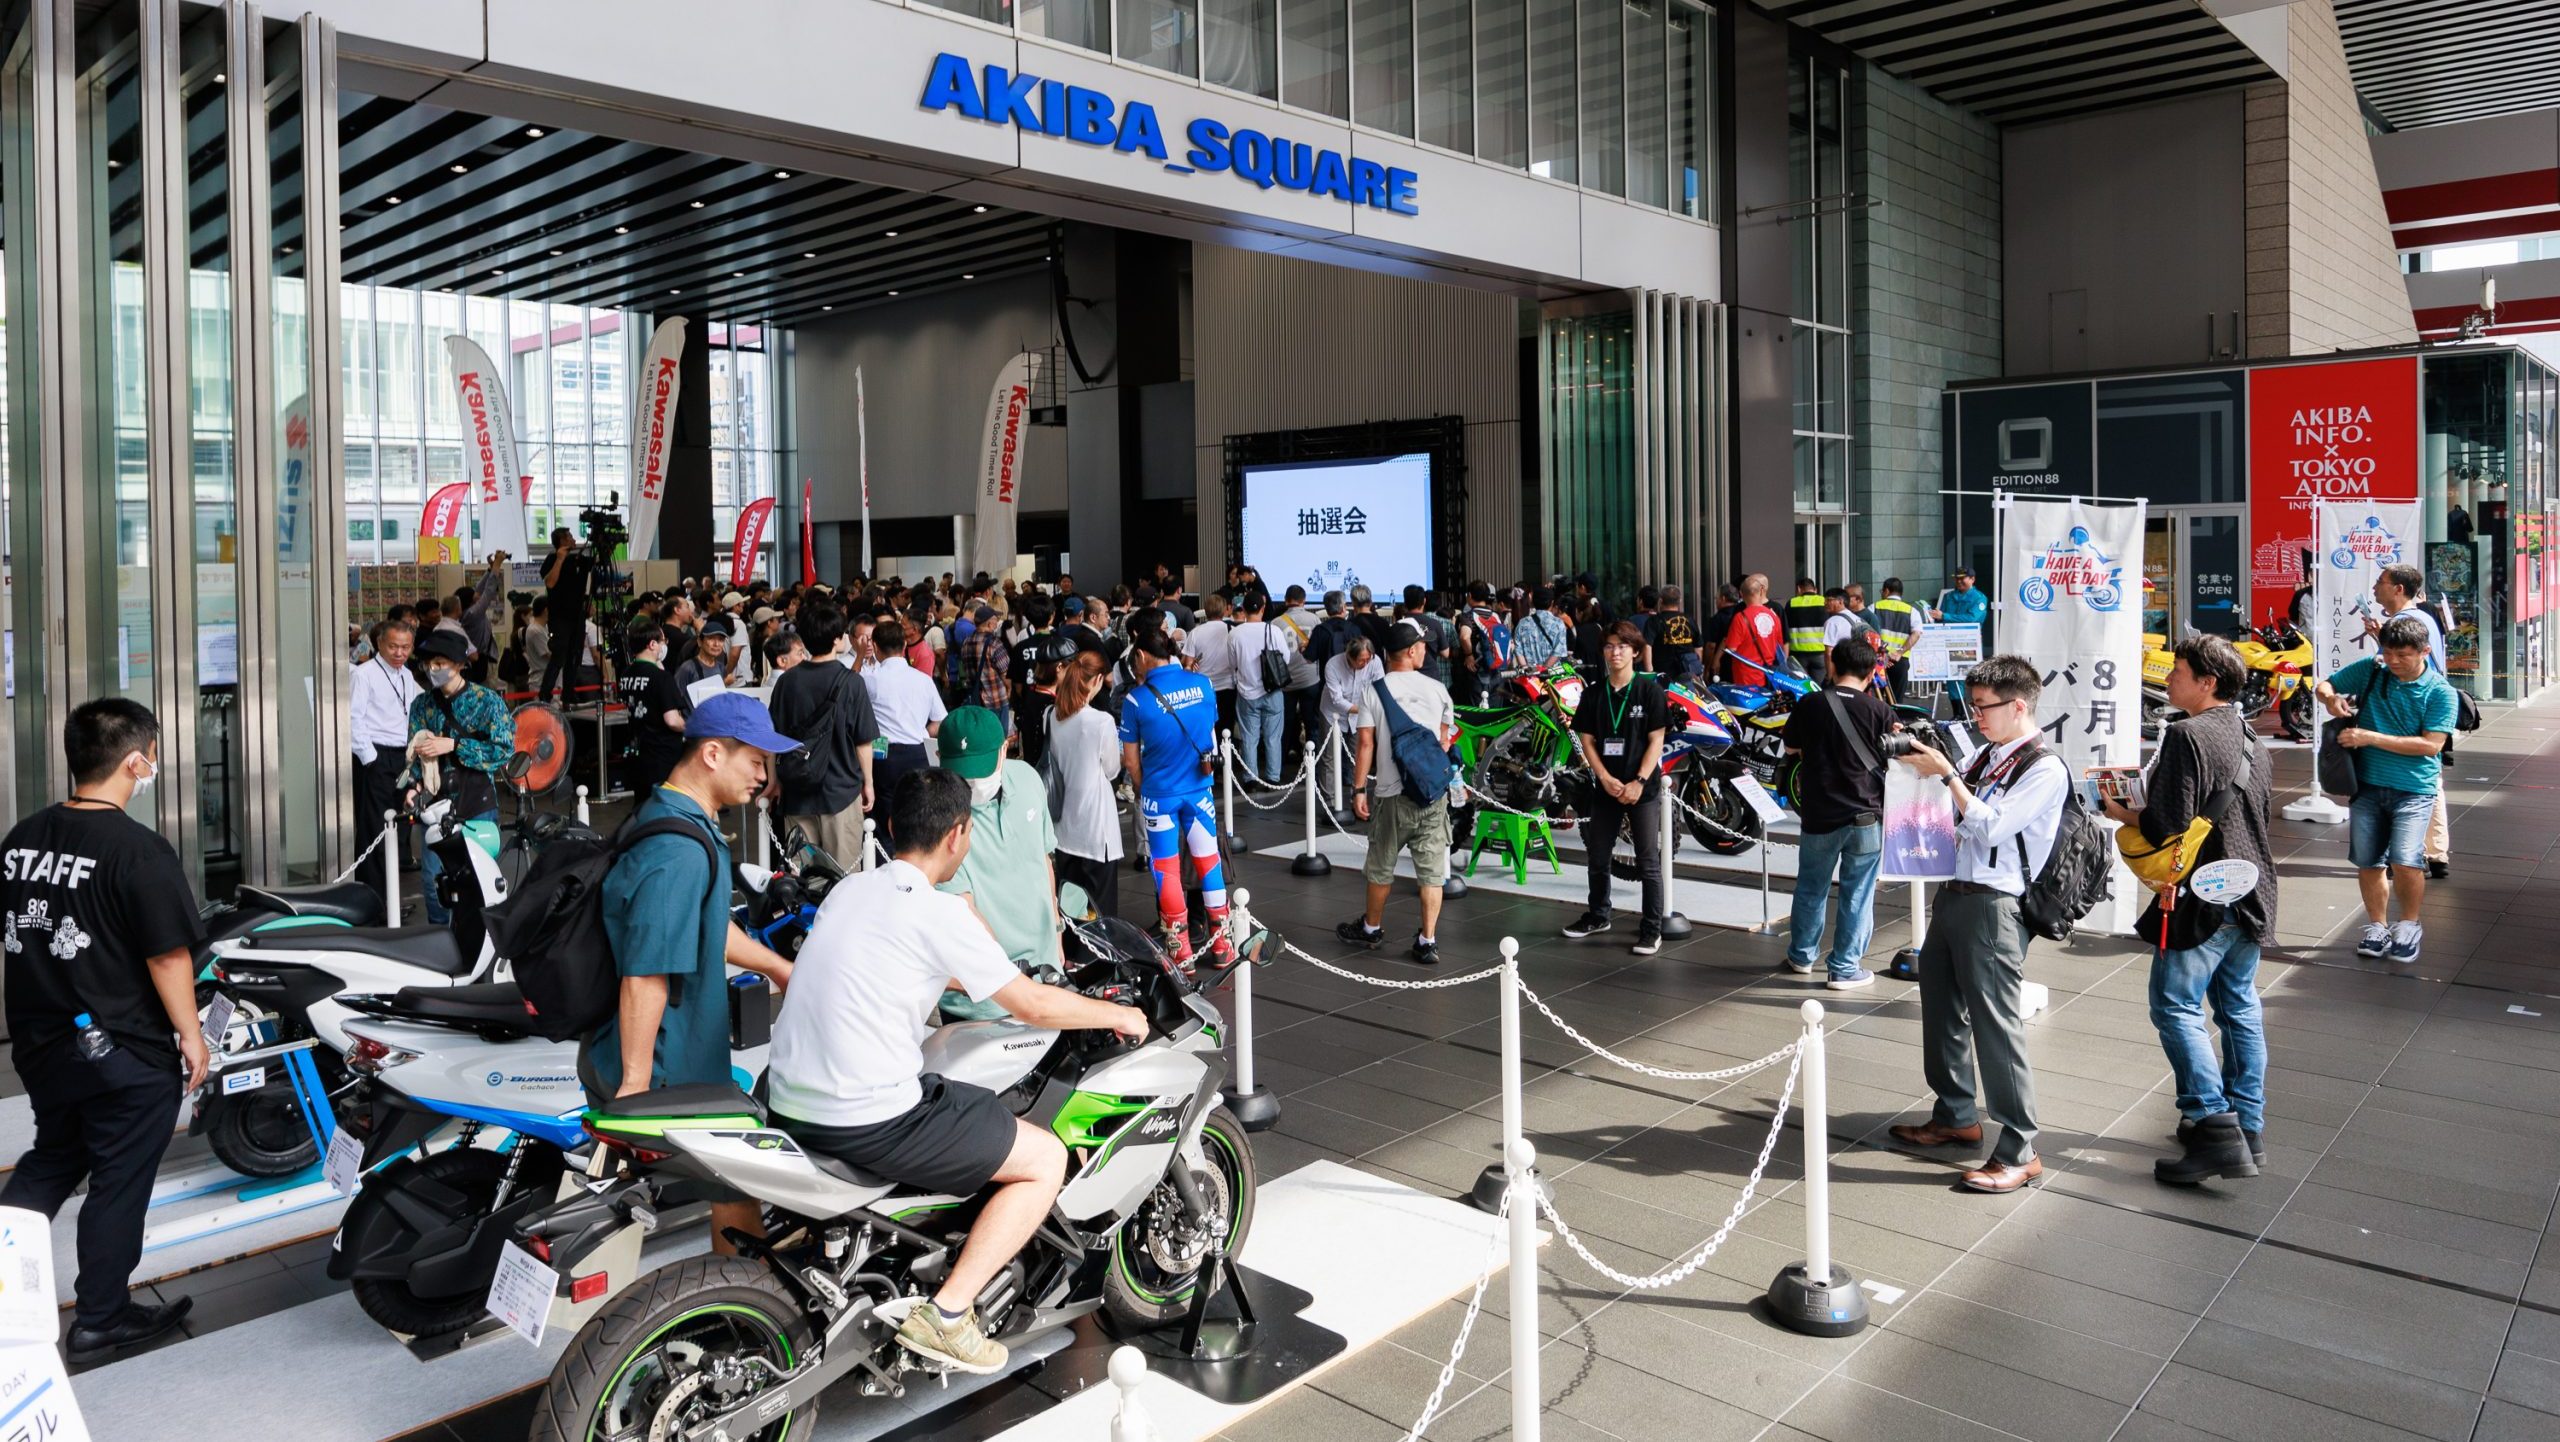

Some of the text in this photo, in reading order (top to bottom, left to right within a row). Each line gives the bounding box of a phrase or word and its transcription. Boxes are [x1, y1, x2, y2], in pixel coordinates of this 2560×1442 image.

[641, 402, 651, 433] Good
[2290, 405, 2373, 427] AKIBA
[643, 357, 677, 501] Kawasaki
[2295, 424, 2372, 446] INFO.
[986, 388, 1007, 497] Let the Good Times Roll
[998, 384, 1028, 504] Kawasaki
[2289, 457, 2376, 478] TOKYO
[2295, 476, 2370, 496] ATOM
[1297, 505, 1368, 536] 抽選会
[738, 510, 762, 582] HONDA
[2349, 534, 2382, 544] HAVE A
[2352, 544, 2393, 554] BIKE DAY
[2045, 555, 2094, 570] HAVE A
[2049, 571, 2110, 586] BIKE DAY
[2197, 573, 2233, 585] 営業中
[2198, 586, 2232, 595] OPEN
[1167, 686, 1204, 704] YAMAHA
[1993, 757, 2015, 776] Canon
[3, 847, 97, 889] STAFF
[1002, 1038, 1046, 1051] Kawasaki
[1164, 1096, 1178, 1105] EV
[1141, 1113, 1177, 1137] Ninja
[2, 1369, 30, 1398] DAY
